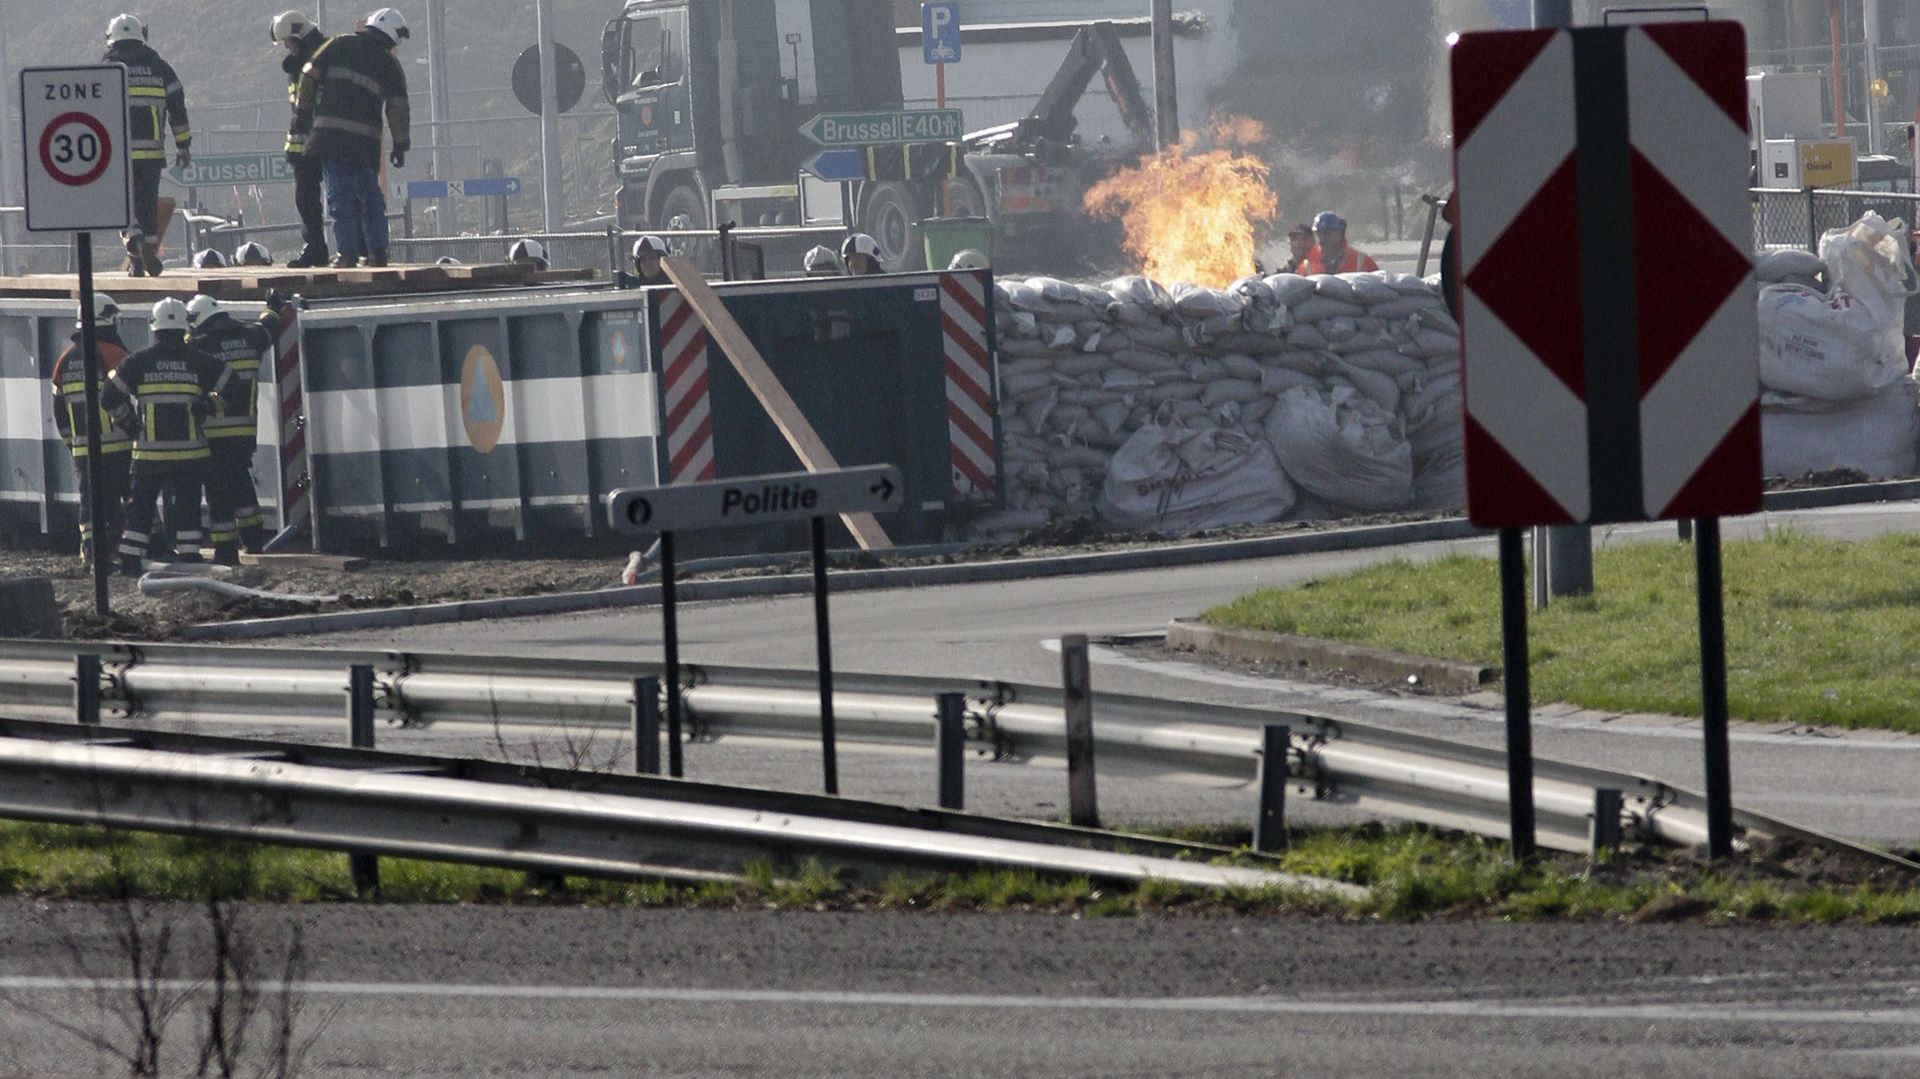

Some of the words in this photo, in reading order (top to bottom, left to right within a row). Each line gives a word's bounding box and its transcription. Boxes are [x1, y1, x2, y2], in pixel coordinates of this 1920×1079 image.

[931, 6, 951, 39] P
[45, 83, 102, 100] ZONE
[823, 115, 898, 140] Brussel
[902, 114, 941, 138] E40
[54, 133, 97, 163] 30
[182, 157, 265, 182] Brussel
[156, 360, 188, 371] CIVIELE
[721, 483, 819, 516] Politie
